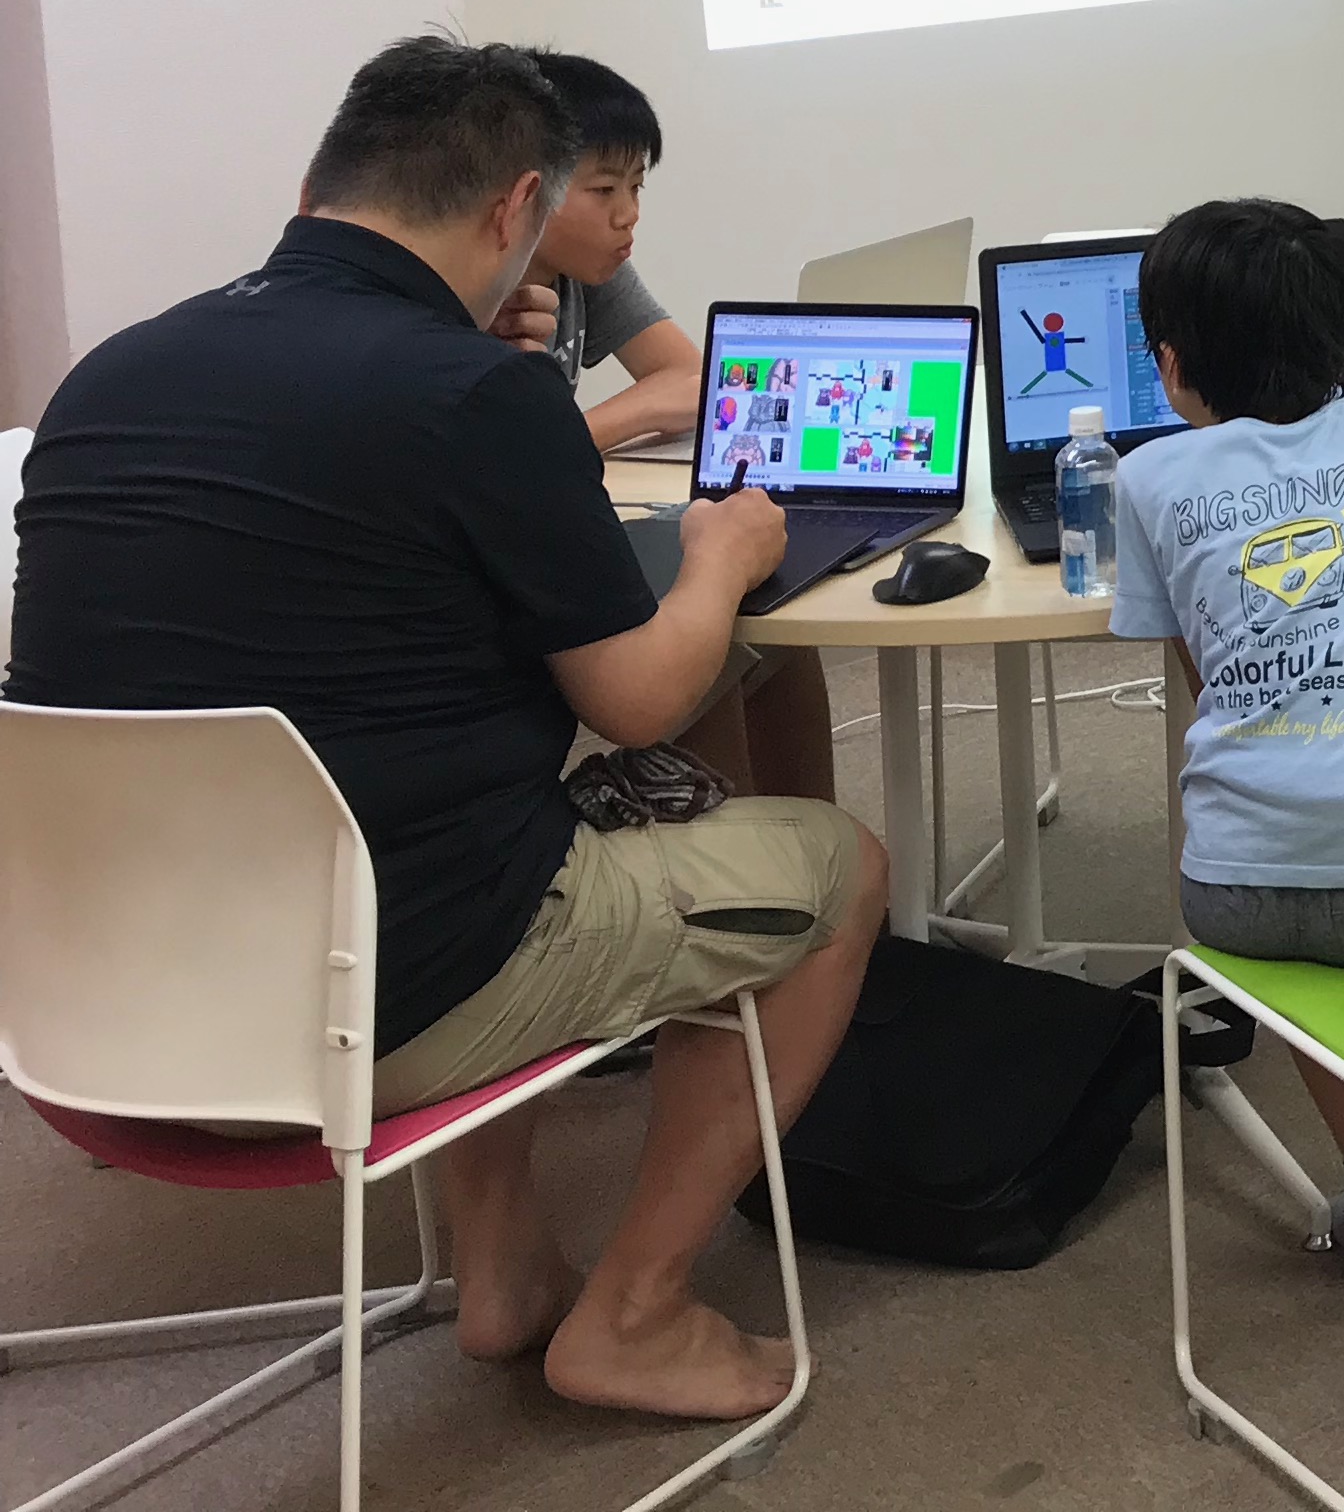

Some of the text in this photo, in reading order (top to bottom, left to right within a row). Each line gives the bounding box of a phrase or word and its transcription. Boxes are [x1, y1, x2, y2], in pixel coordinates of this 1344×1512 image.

[1172, 492, 1237, 546] BIG
[1228, 689, 1254, 709] the
[1291, 719, 1317, 746] my
